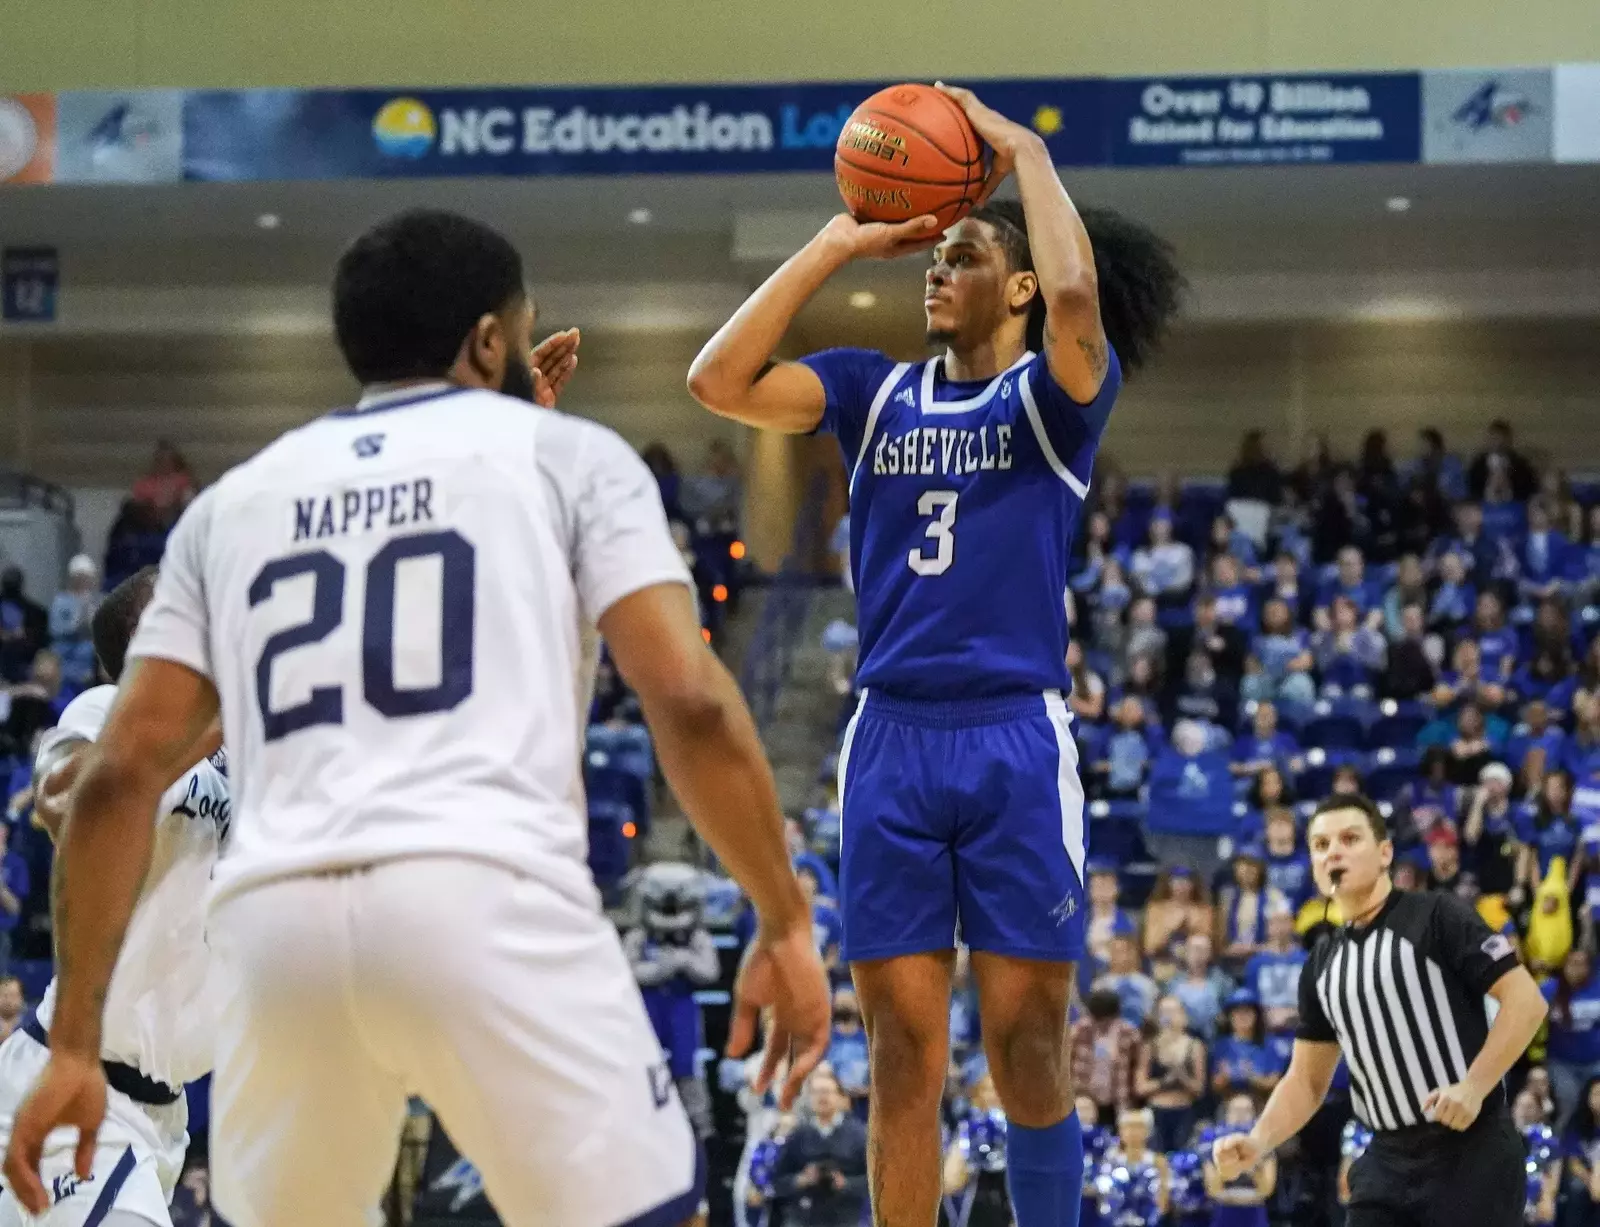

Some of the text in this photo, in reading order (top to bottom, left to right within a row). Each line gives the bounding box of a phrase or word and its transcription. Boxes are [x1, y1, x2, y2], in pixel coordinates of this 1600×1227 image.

[440, 108, 516, 153] NC
[523, 101, 774, 151] Education
[873, 424, 1013, 476] ASHEVILLE
[293, 477, 434, 542] NAPPER
[908, 490, 959, 576] 3
[247, 528, 476, 742] 20
